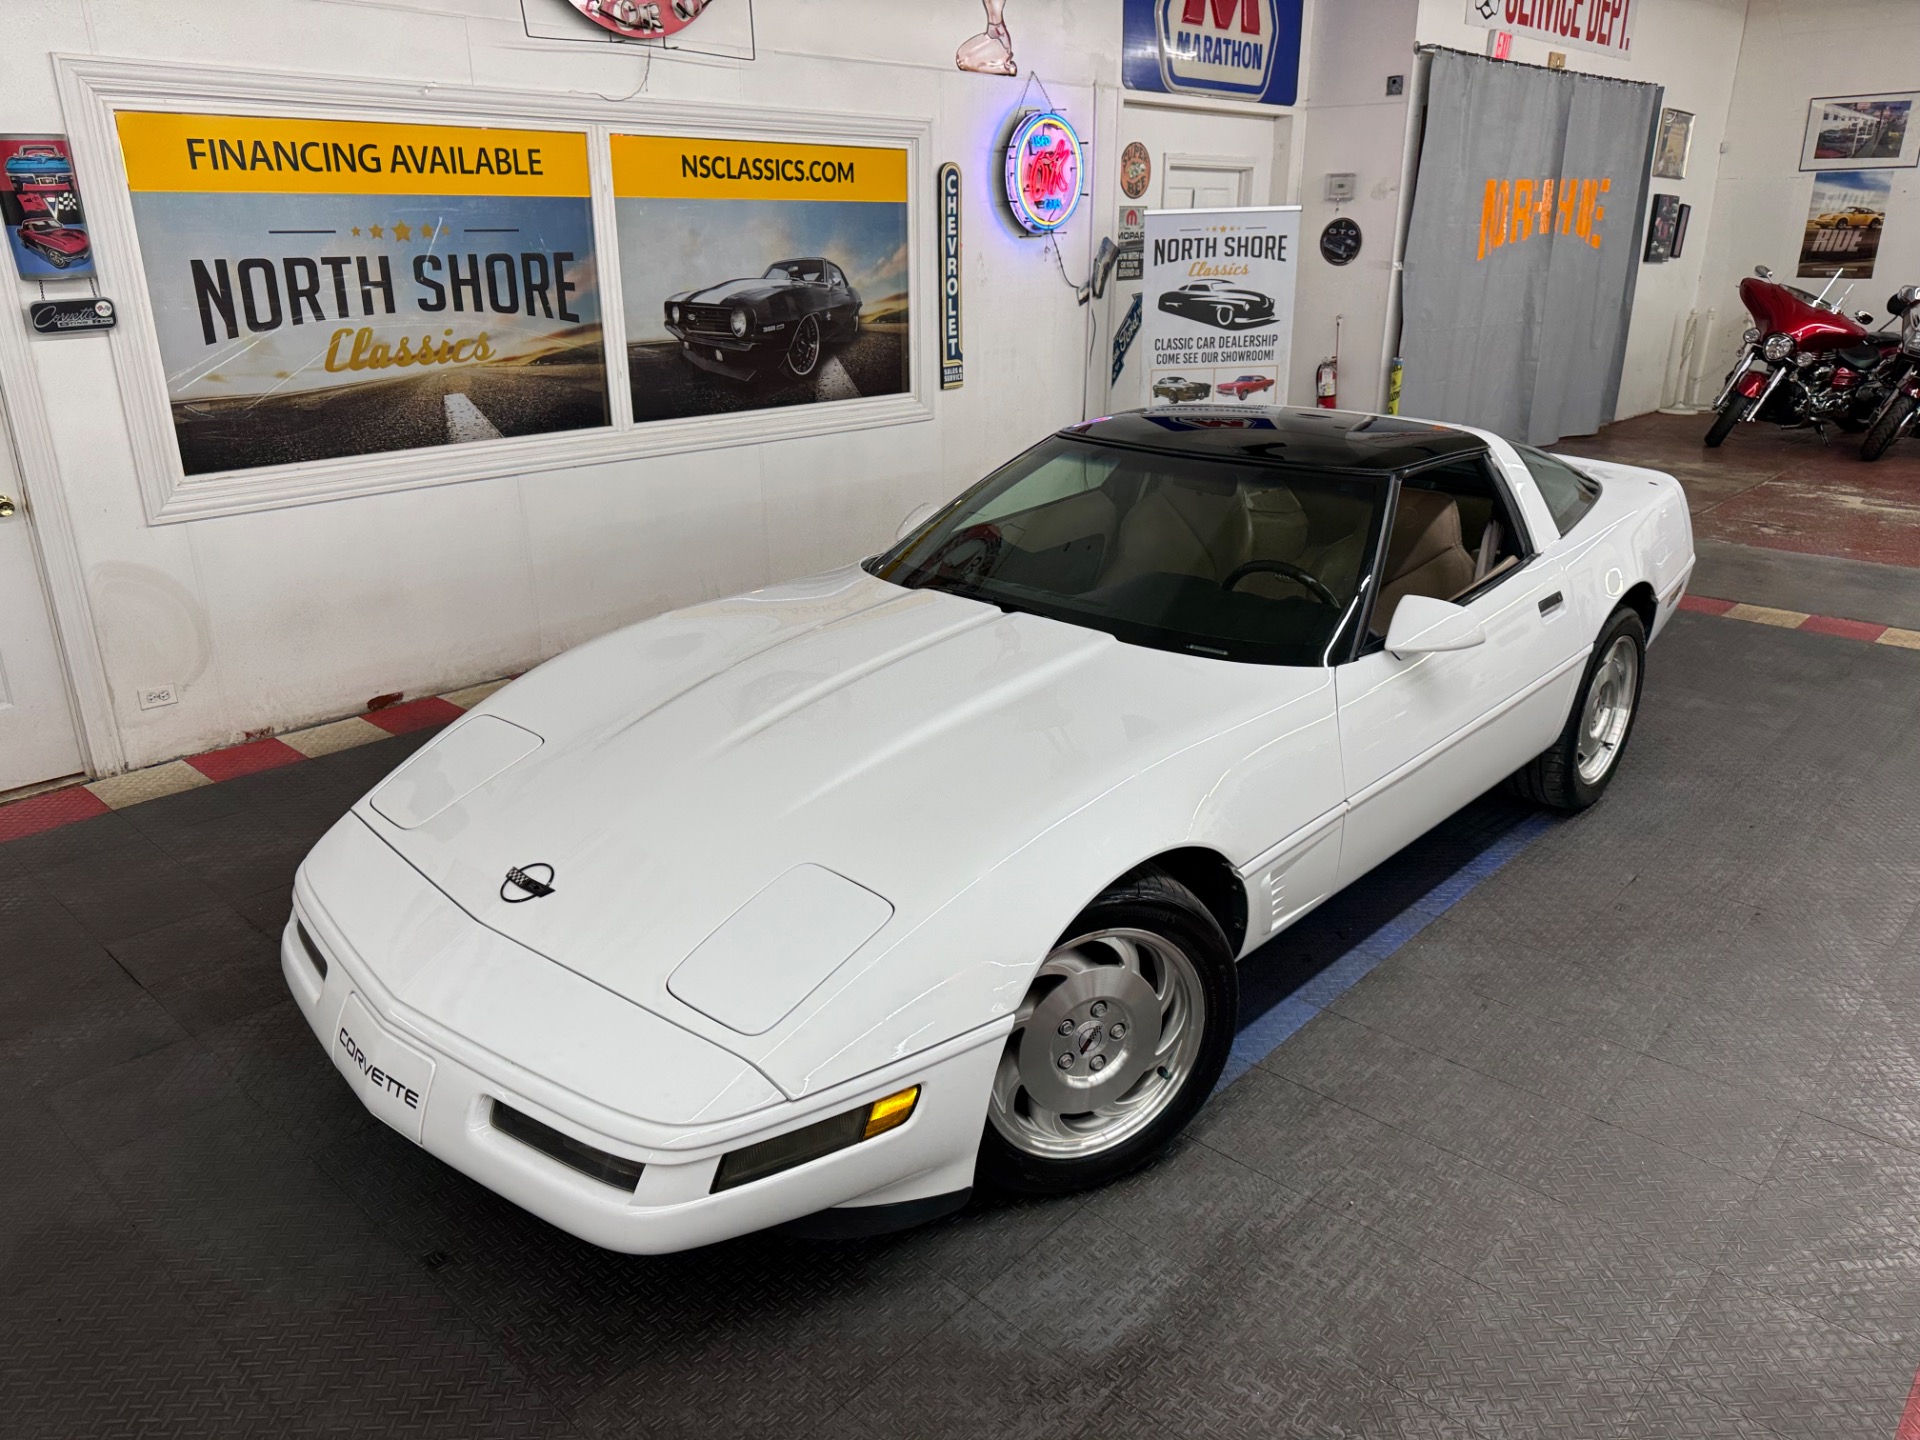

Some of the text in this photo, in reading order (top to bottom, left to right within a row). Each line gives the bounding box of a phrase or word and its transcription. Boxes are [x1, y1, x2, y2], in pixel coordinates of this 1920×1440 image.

[1176, 31, 1263, 70] MARATHON
[186, 138, 544, 175] FINANCING AVAILABLE
[681, 154, 855, 184] NSCLASSICS.COM
[1126, 176, 1146, 196] BEE
[1118, 231, 1145, 240] MOPAR
[1328, 227, 1357, 236] GTO
[1811, 229, 1865, 252] RIDE
[1153, 235, 1288, 267] NORTH SHORE
[946, 174, 958, 356] CHEVROLET
[1188, 261, 1250, 277] Classics
[190, 252, 580, 345] NORTH SHORE
[33, 306, 99, 328] Corvette
[323, 327, 497, 373] Classics
[1154, 334, 1279, 351] CLASSIC CAR DEALERSHIP
[1156, 349, 1275, 365] COME SEE OUR SHOWROOM!
[339, 1027, 420, 1110] CORVETTE
